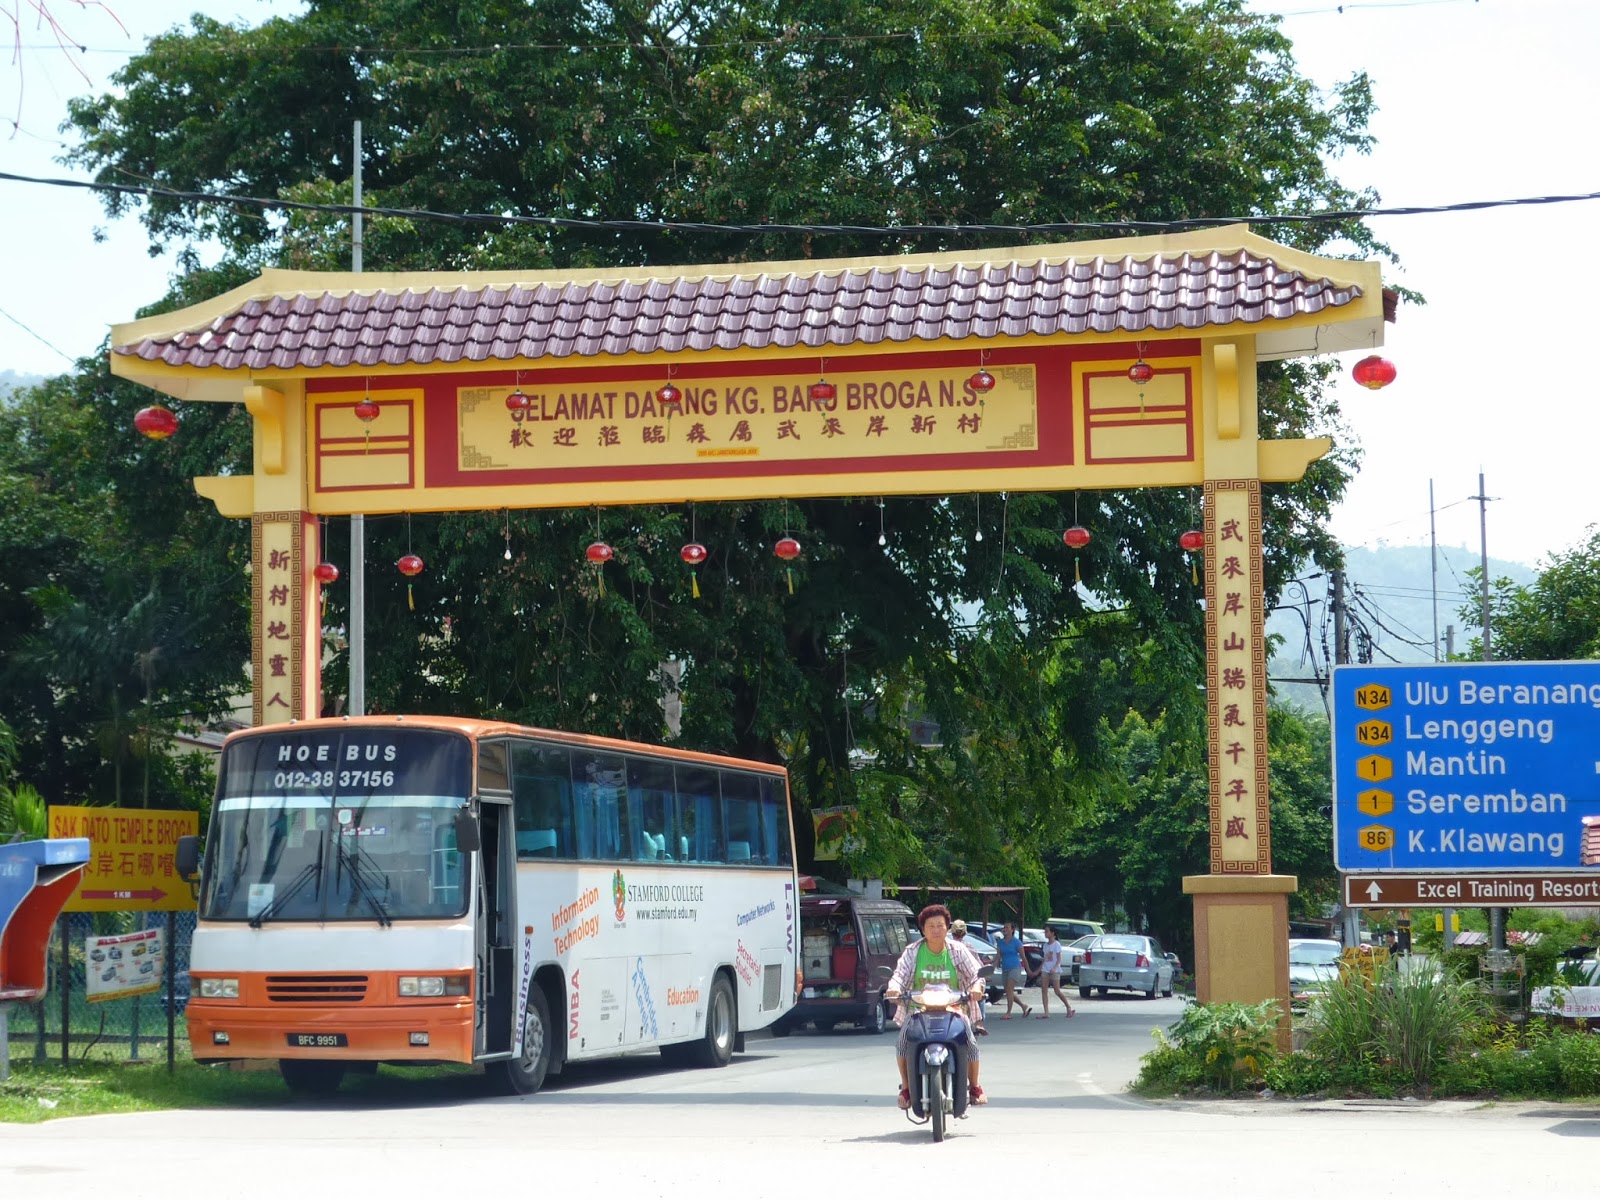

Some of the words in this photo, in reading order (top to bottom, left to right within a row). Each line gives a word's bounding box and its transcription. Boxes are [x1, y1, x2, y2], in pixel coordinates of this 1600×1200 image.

[725, 386, 765, 415] KG.
[846, 381, 933, 411] BROGA
[1405, 681, 1449, 705] Ulu
[1406, 715, 1554, 744] Lenggeng
[278, 745, 330, 761] HOE
[346, 745, 396, 761] BUS
[1370, 760, 1377, 776] 1
[1406, 750, 1506, 776] Mantin
[274, 770, 334, 789] 012-38
[339, 770, 395, 787] 37156
[1371, 795, 1378, 809] 1
[1407, 789, 1566, 814] Seremban
[54, 815, 78, 838] SAK
[113, 818, 153, 845] TEMPLE
[1367, 831, 1387, 845] 86
[1409, 828, 1564, 857] K.Klawang
[628, 885, 669, 902] STAMFORD
[671, 885, 704, 902] COLLEGE
[1417, 881, 1461, 897] Excel
[1468, 881, 1535, 901] Training
[1541, 880, 1600, 897] Resort
[552, 886, 600, 931] Information
[636, 906, 698, 922] www.stamford.edu.my
[737, 909, 757, 927] Computer
[756, 899, 776, 917] Networks
[785, 884, 793, 954] Law
[554, 914, 600, 957] Technology
[735, 956, 752, 987] Studies
[737, 939, 761, 977] Secretarial
[921, 970, 950, 979] THE
[515, 938, 531, 1044] Business
[569, 968, 580, 1040] MBA
[636, 956, 658, 1040] Cambridge
[667, 985, 699, 1006] Education
[298, 1035, 315, 1045] BFC
[317, 1035, 337, 1045] 9951
